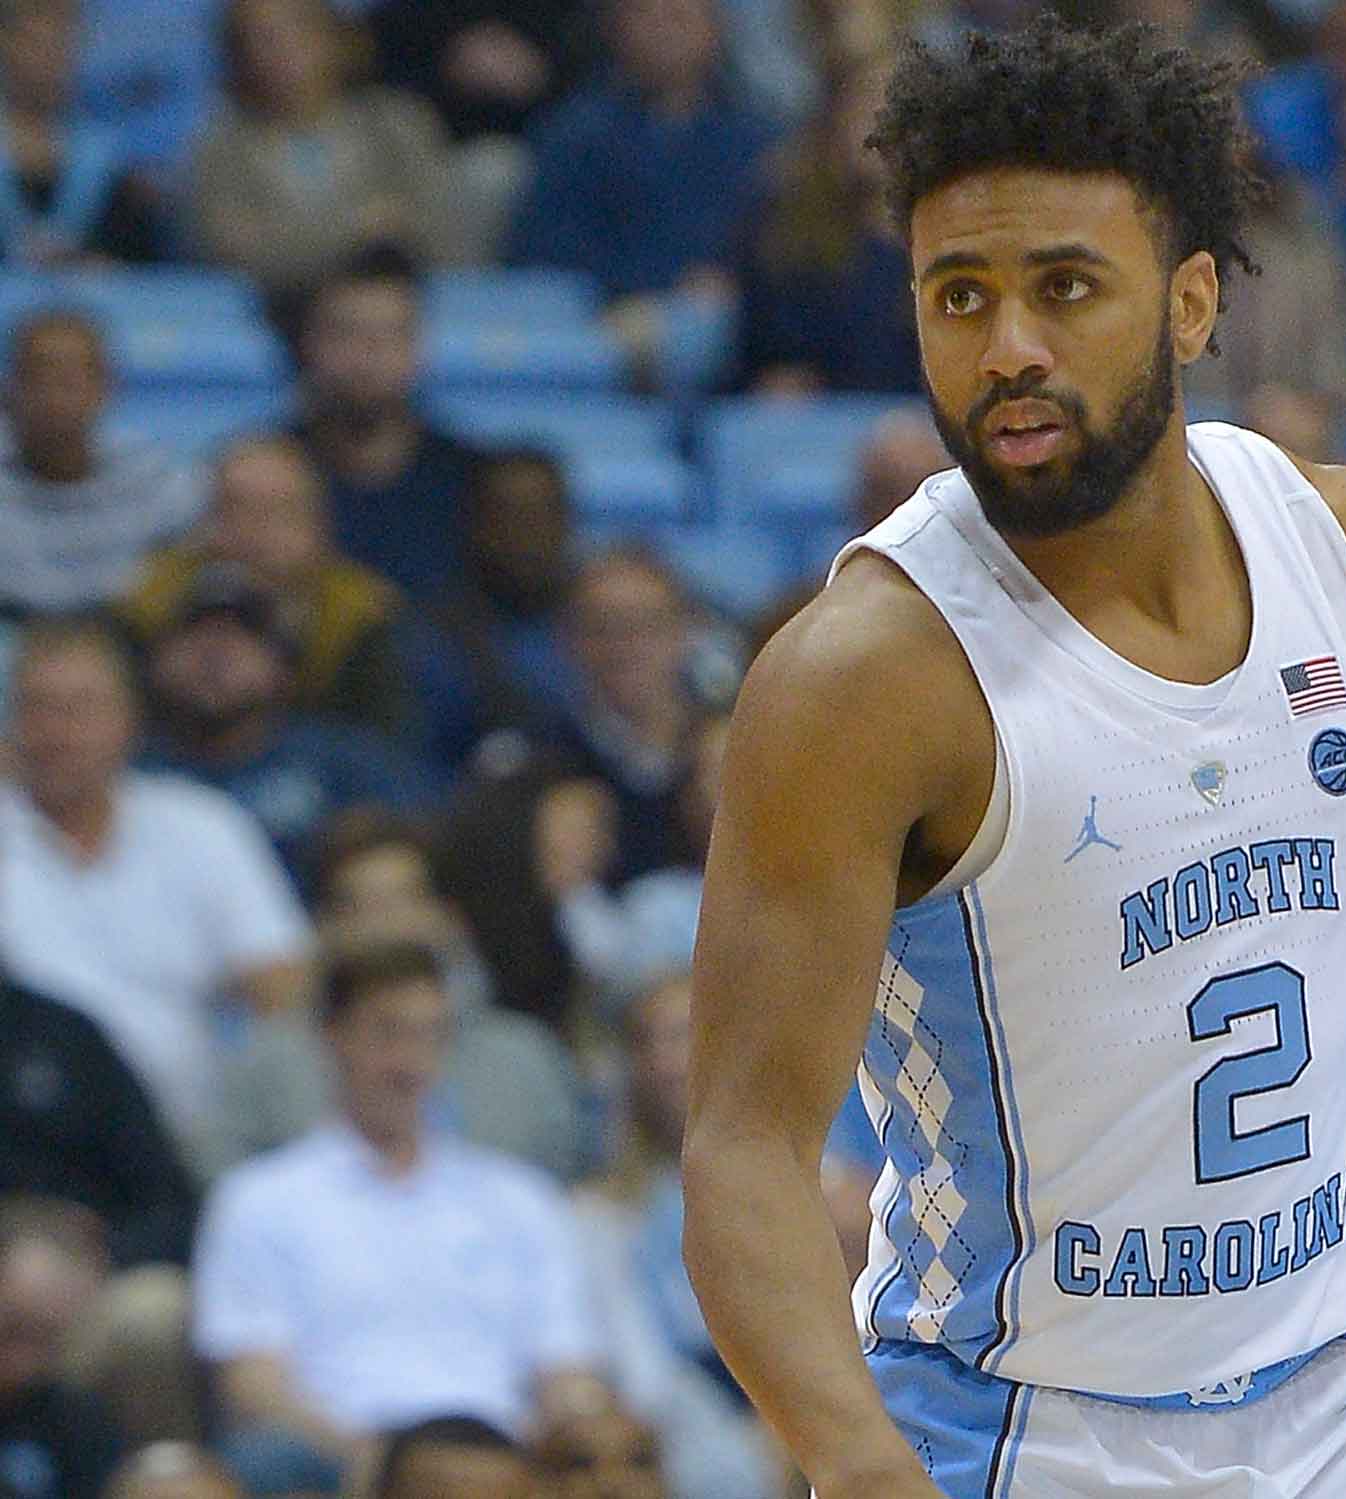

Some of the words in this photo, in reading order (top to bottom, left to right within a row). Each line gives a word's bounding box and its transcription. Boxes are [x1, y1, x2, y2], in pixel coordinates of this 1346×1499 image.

[1120, 838, 1340, 970] NORTH
[1186, 960, 1313, 1185] 2
[1054, 1172, 1343, 1298] CAROLIN
